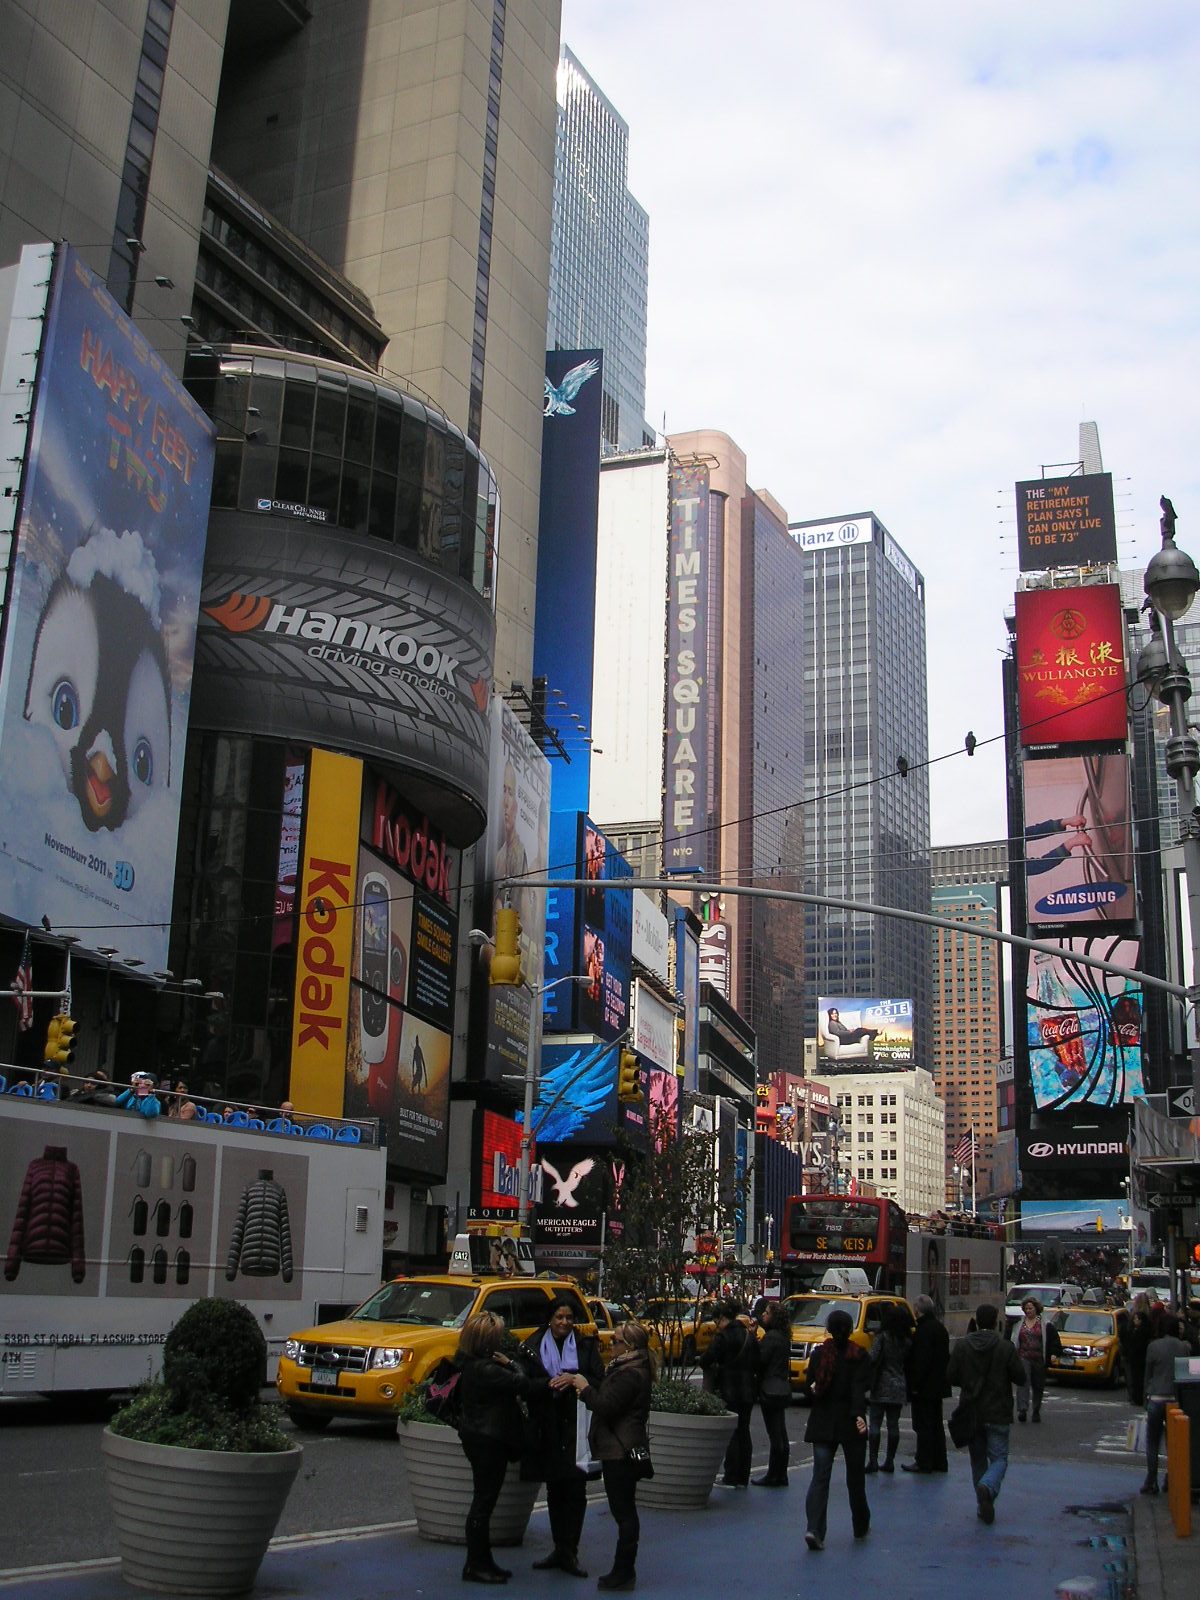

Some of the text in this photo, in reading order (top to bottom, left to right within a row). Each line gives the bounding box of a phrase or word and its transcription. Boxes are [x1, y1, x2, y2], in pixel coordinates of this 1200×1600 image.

[80, 325, 151, 426] HAPPY
[152, 401, 197, 486] FEET
[1026, 489, 1045, 499] THE
[1026, 496, 1090, 511] RETIREMENT
[293, 511, 326, 521] SPECACOLOR
[1027, 511, 1053, 522] PLAN
[1056, 508, 1082, 520] SAYS
[1028, 518, 1102, 534] CAN ONLY LIVE
[1028, 535, 1041, 545] TO
[1044, 534, 1057, 544] BE
[671, 497, 702, 826] TIMES SQUARE
[307, 644, 457, 703] driving emotion
[1023, 666, 1118, 681] WULIANGYE
[373, 781, 453, 904] Kodak
[672, 847, 693, 856] NYC
[44, 832, 87, 865] Novemburr
[88, 854, 107, 876] 2011
[113, 860, 136, 892] 3D
[1047, 891, 1116, 906] SAMSUNG
[297, 857, 351, 1050] Kodak
[866, 1003, 906, 1016] ROSIE
[1057, 1142, 1123, 1154] HYUNDAI
[494, 1151, 521, 1198] Ban
[537, 1219, 597, 1227] MERICAN EAGLE
[541, 1250, 584, 1258] AMERICAN
[827, 1254, 867, 1262] Sightseeing
[4, 1333, 167, 1345] 53RD ST GLOBAL FLAGSHIP STORE
